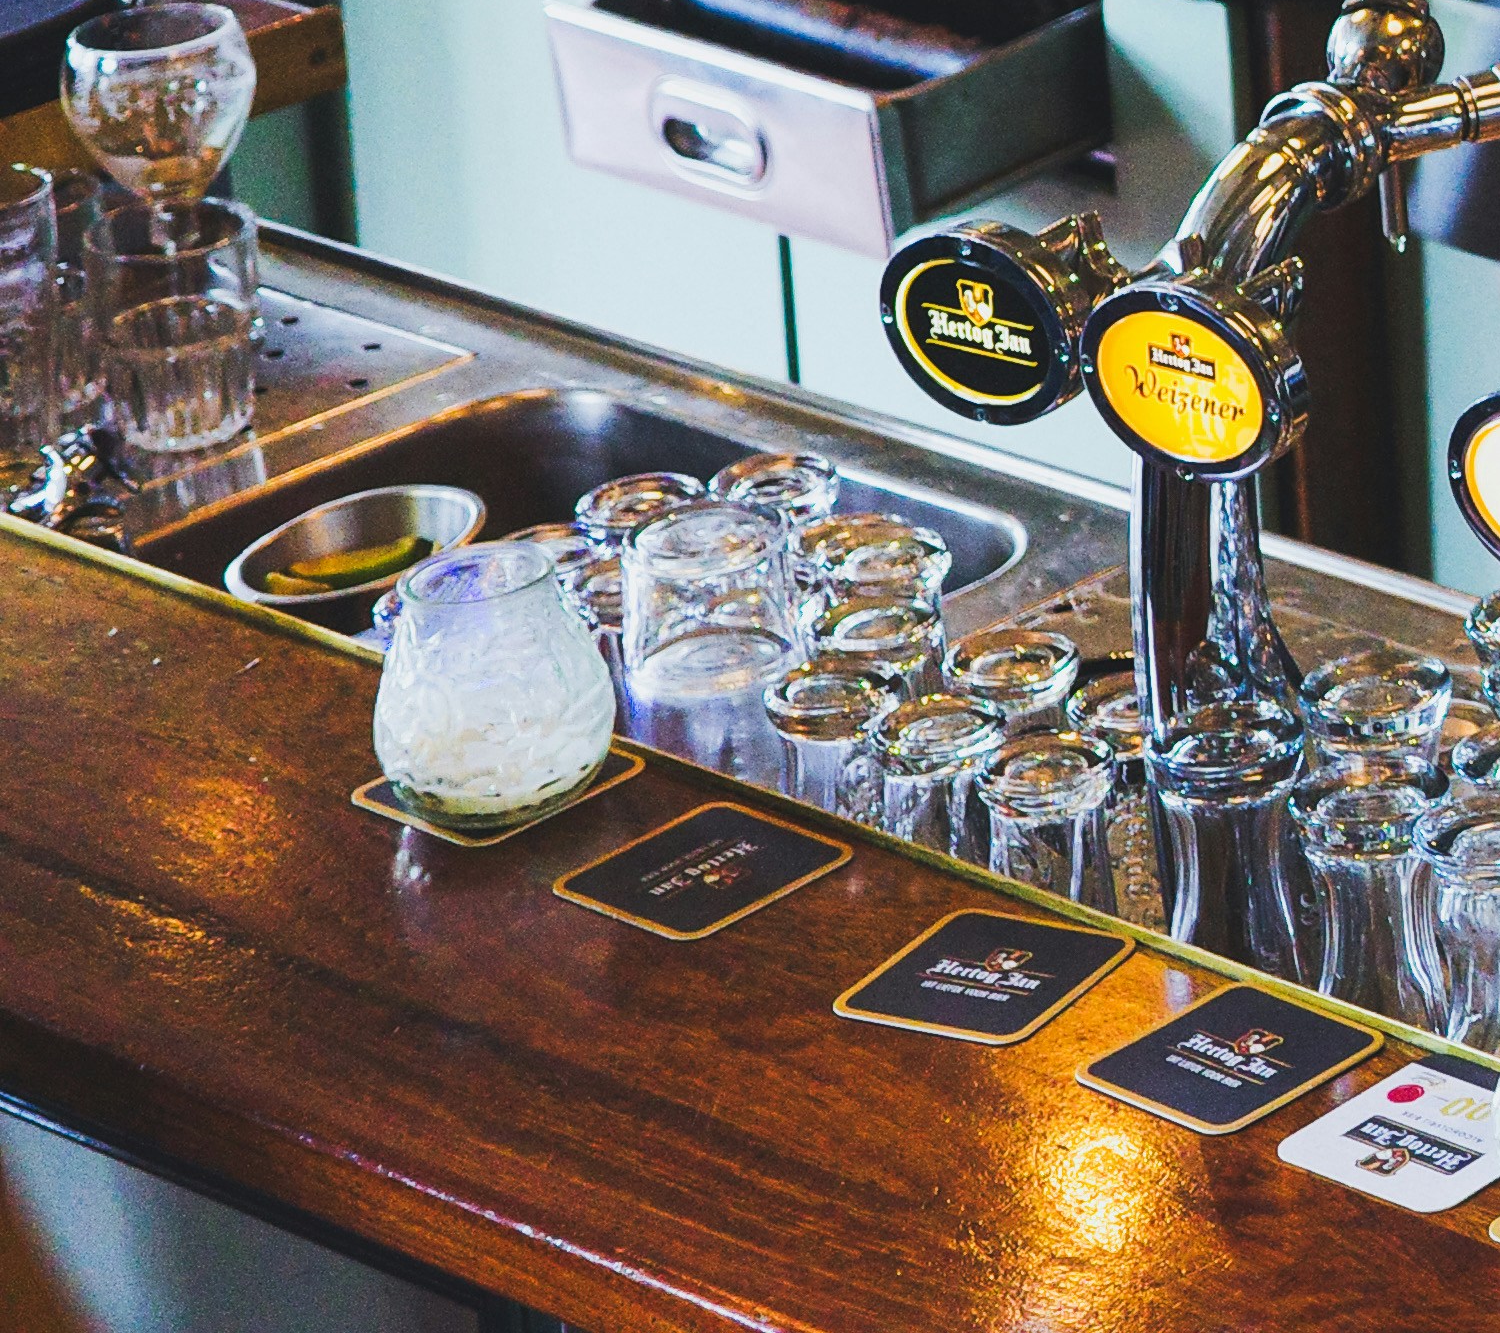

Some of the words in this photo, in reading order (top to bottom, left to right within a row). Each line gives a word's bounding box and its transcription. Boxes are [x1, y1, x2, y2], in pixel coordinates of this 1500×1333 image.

[928, 308, 996, 351] Hertog
[993, 323, 1033, 356] Jan
[1150, 347, 1192, 374] Hertog
[1188, 359, 1216, 378] Jan
[1123, 363, 1247, 424] Weizener
[1176, 1032, 1246, 1067] Hertog
[1233, 1056, 1278, 1079] Jan
[1359, 1121, 1409, 1145] Jan
[1395, 1129, 1473, 1171] Hertog
